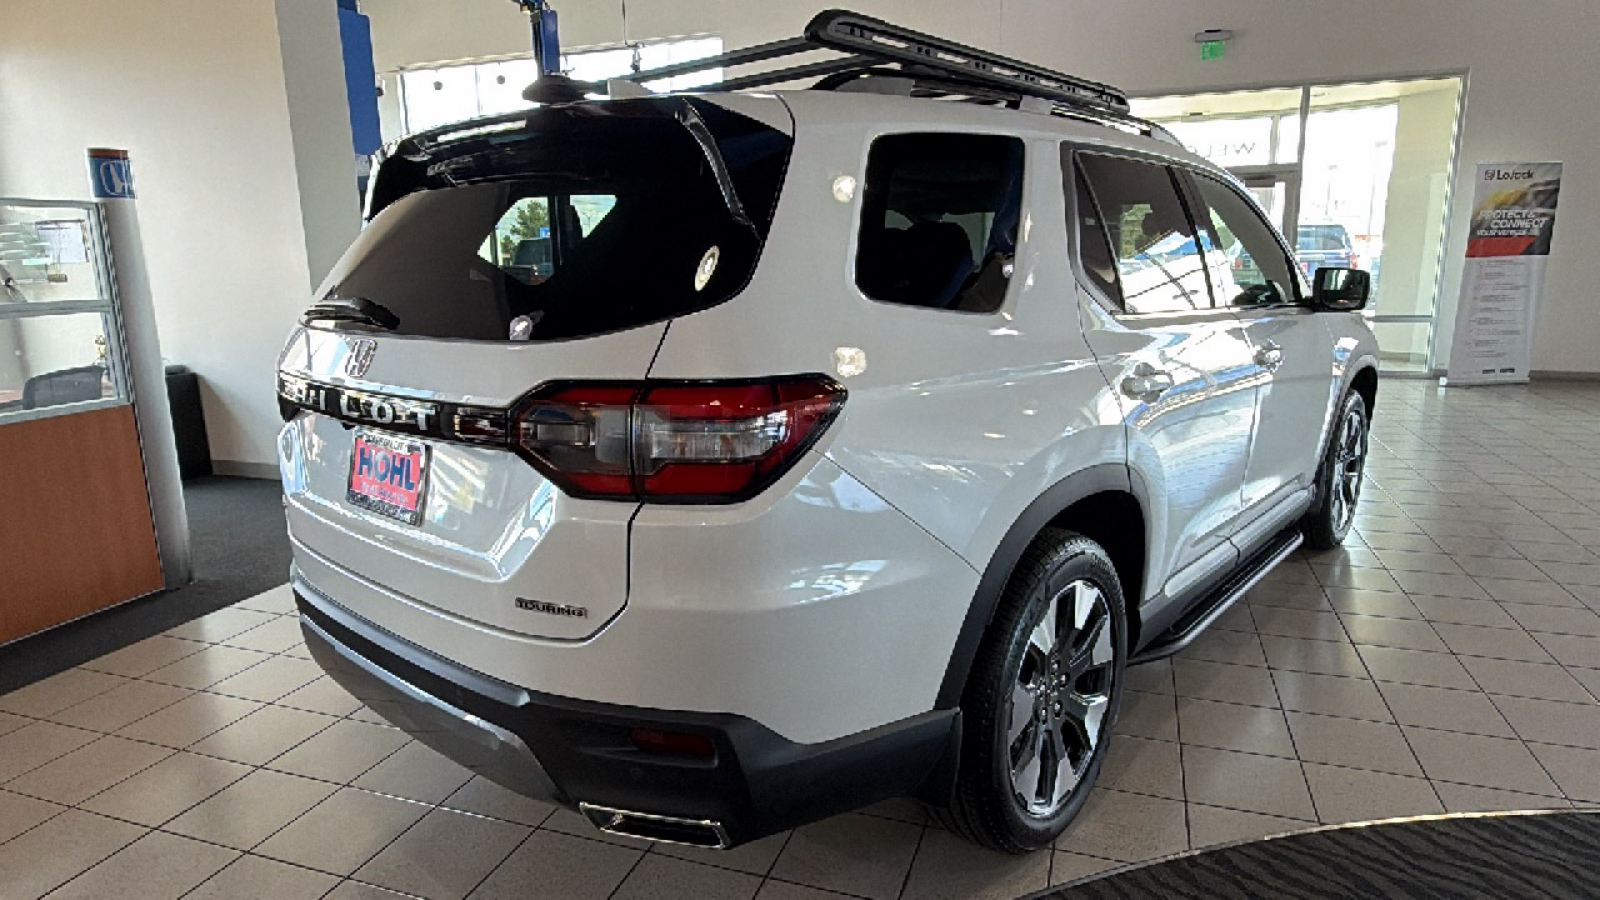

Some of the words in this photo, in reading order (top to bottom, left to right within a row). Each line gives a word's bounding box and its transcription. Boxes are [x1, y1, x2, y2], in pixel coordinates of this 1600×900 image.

[1479, 209, 1527, 220] PROTECT
[1490, 218, 1546, 229] CONNECT
[358, 446, 415, 491] HOHL
[515, 597, 587, 618] TOURING
